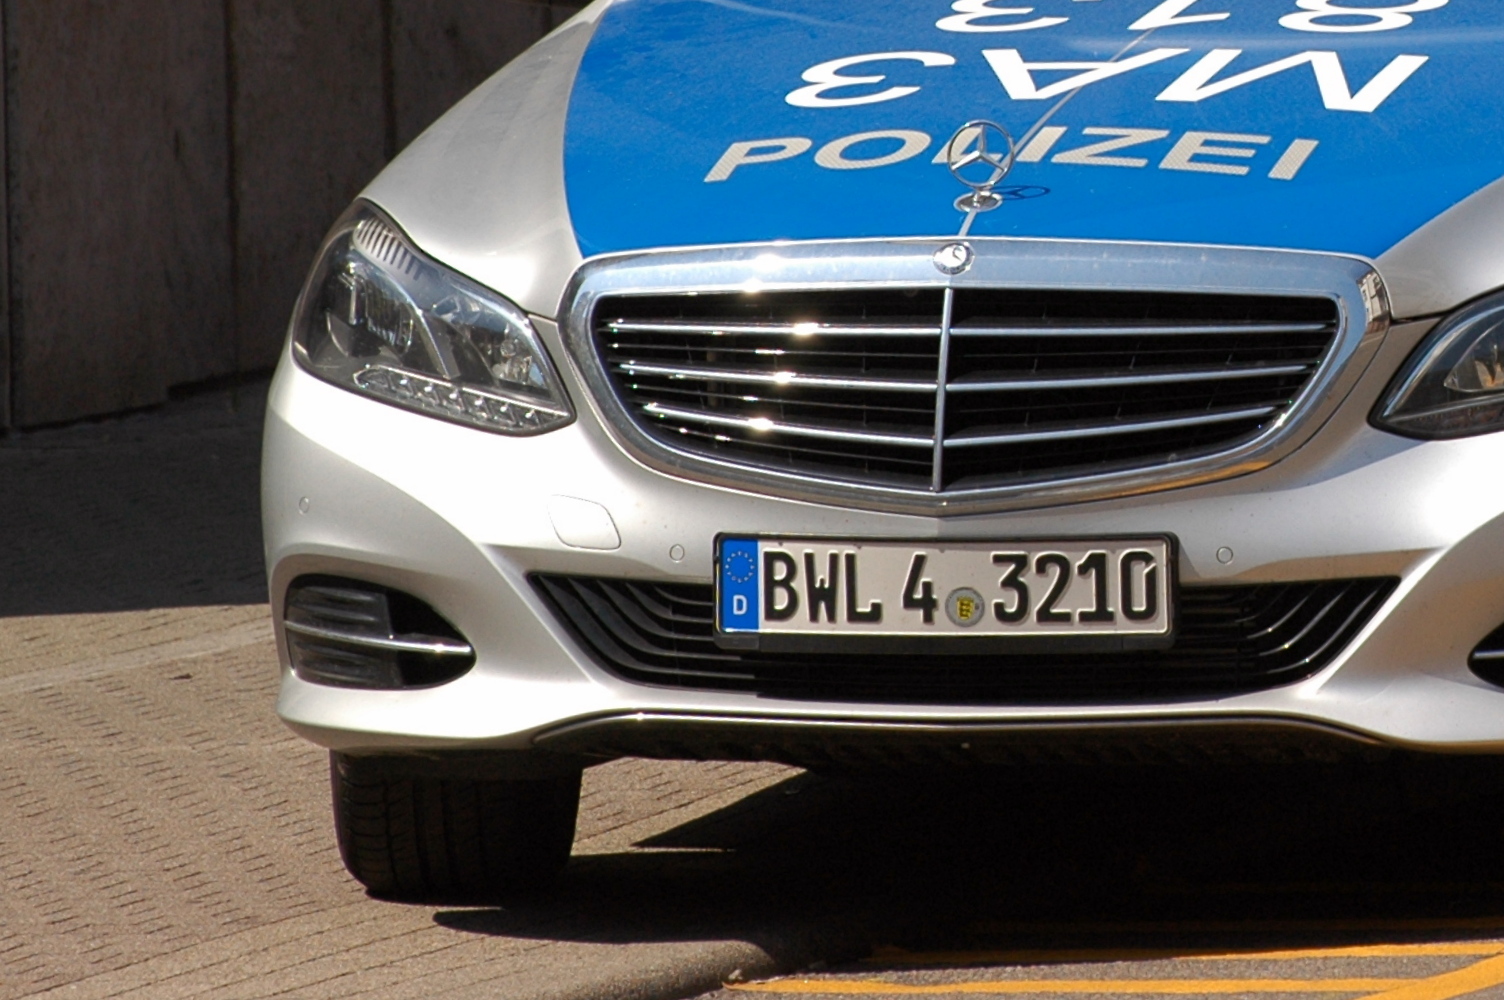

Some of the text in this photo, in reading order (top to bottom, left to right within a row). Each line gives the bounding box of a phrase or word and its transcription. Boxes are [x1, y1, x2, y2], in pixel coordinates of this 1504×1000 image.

[703, 126, 1320, 183] POLIZEI
[731, 549, 1158, 625] D BWL 4 3210
